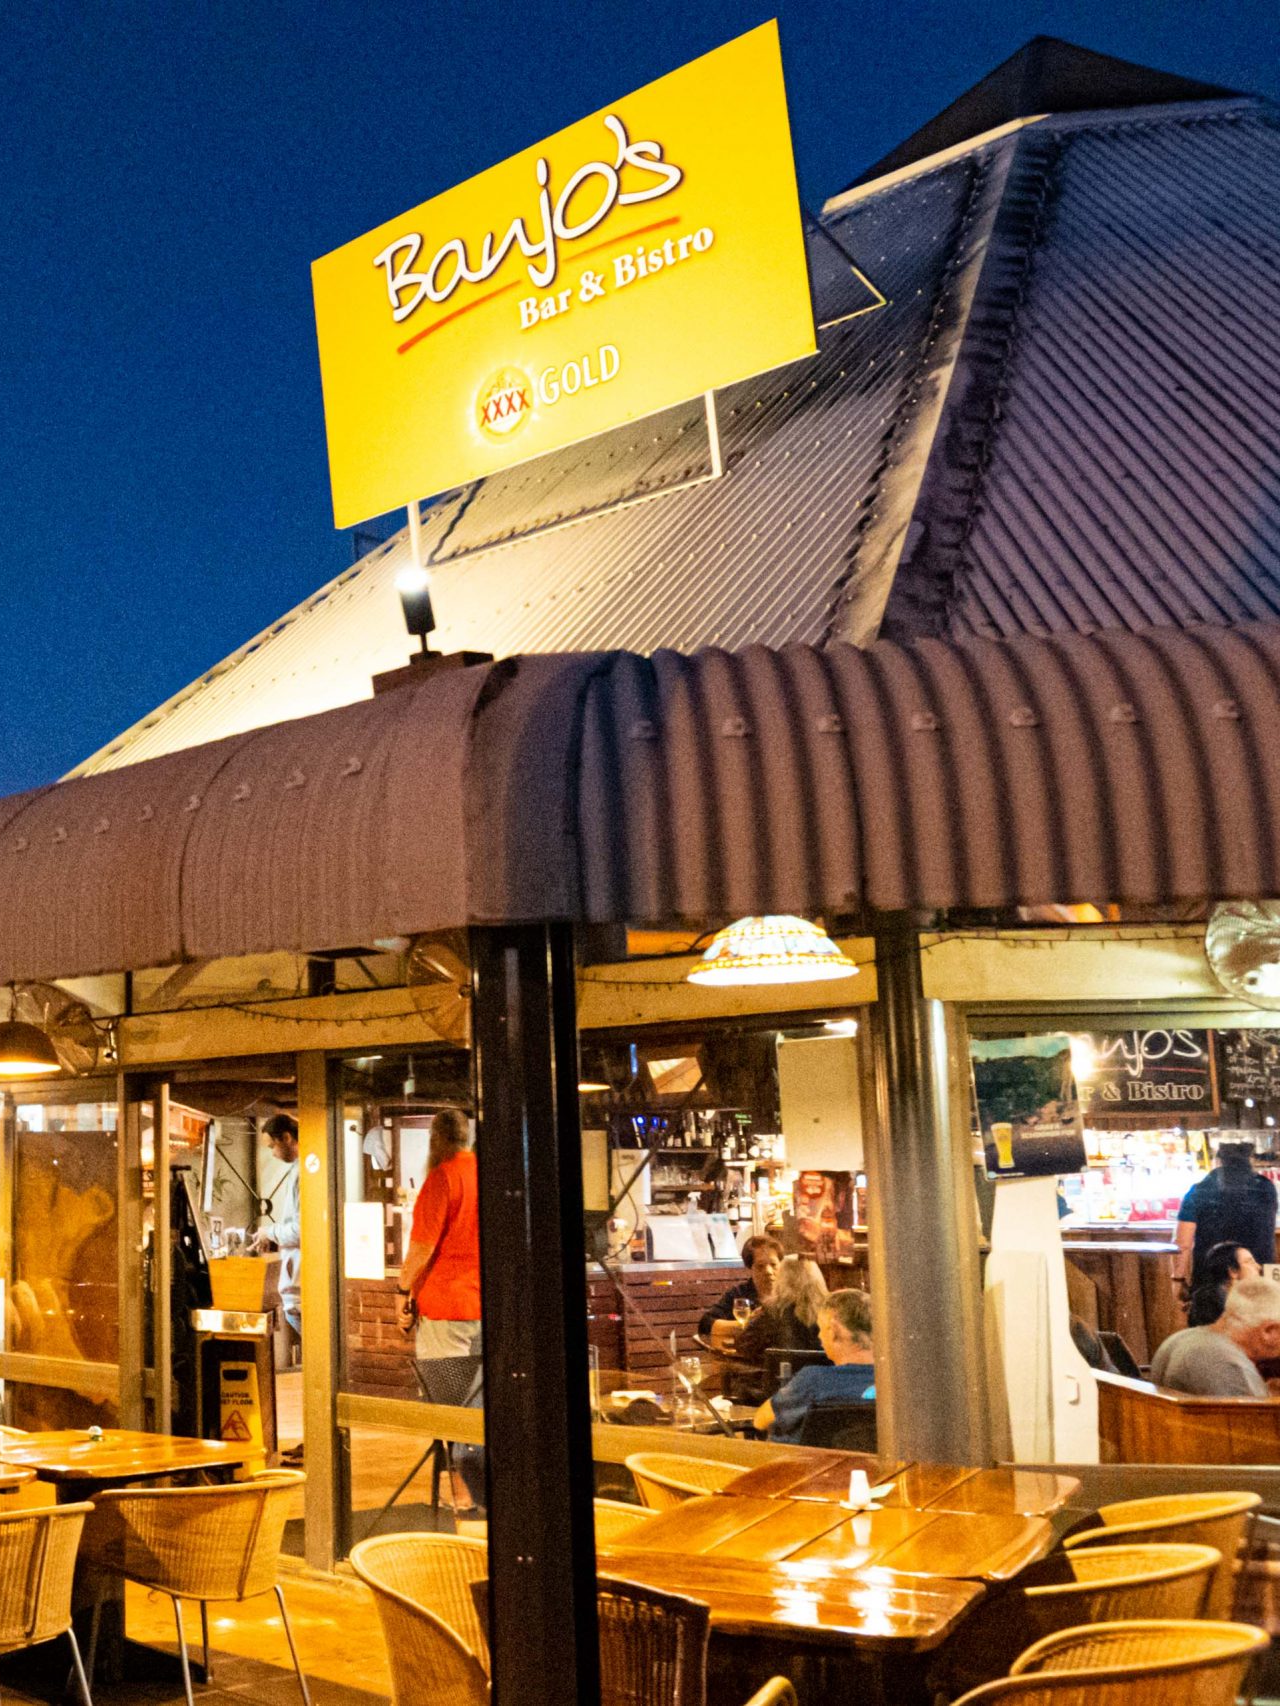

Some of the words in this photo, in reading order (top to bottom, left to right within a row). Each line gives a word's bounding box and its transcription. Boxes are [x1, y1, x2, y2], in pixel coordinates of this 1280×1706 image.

[372, 113, 684, 325] Banjo's
[517, 285, 573, 333] Bar
[578, 268, 606, 304] &
[613, 225, 716, 292] Bistro
[480, 388, 531, 428] XXXX
[539, 344, 621, 405] GOLD
[1102, 1081, 1122, 1101] &
[1127, 1080, 1205, 1101] Bistro
